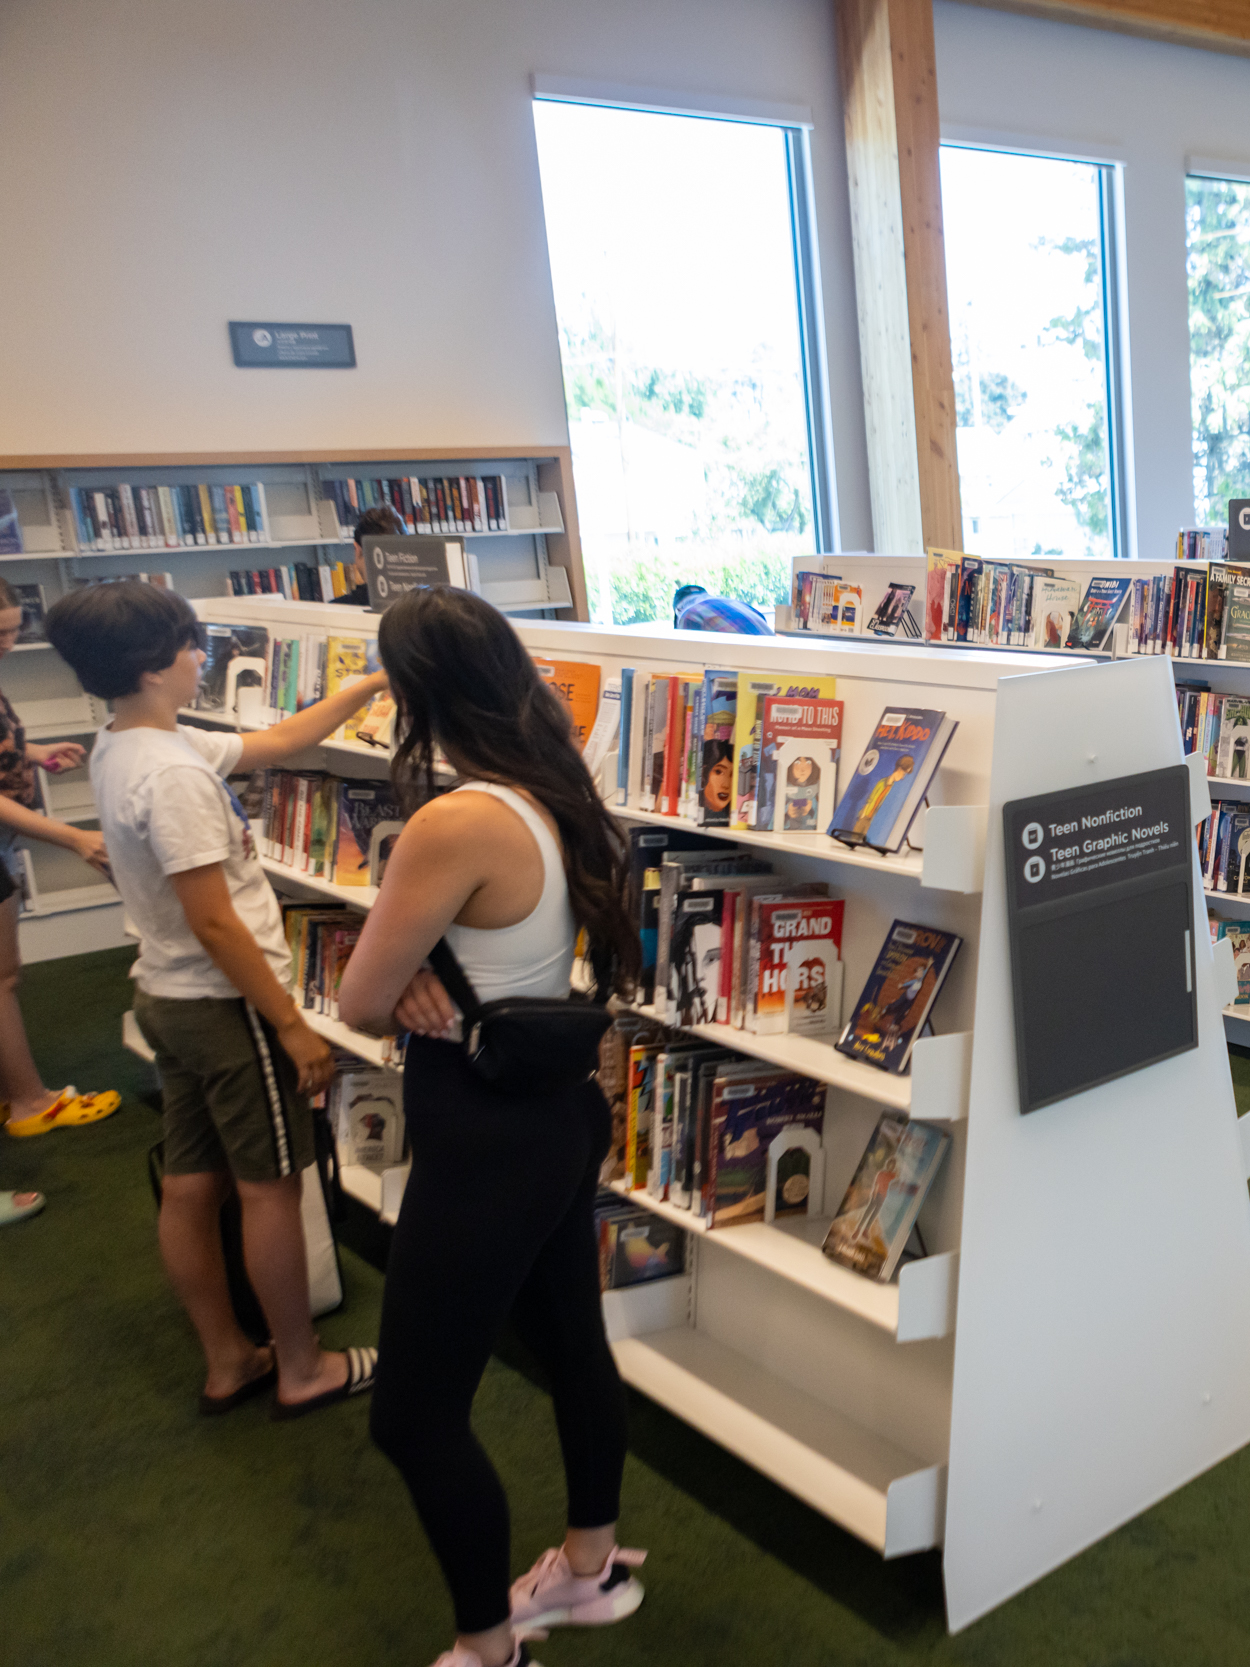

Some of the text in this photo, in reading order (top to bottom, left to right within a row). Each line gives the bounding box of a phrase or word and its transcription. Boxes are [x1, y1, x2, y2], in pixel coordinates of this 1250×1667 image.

[385, 551, 418, 563] Teen Fiction
[1216, 574, 1236, 585] FAMILY
[803, 706, 814, 724] TO
[817, 707, 839, 726] THIS
[896, 720, 930, 741] KIDDO
[354, 802, 399, 817] BEAST
[1049, 805, 1143, 837] Teen Nonfiction
[1050, 821, 1169, 862] Teen Graphic Novels
[774, 917, 832, 938] GRAND
[763, 965, 825, 994] HORS
